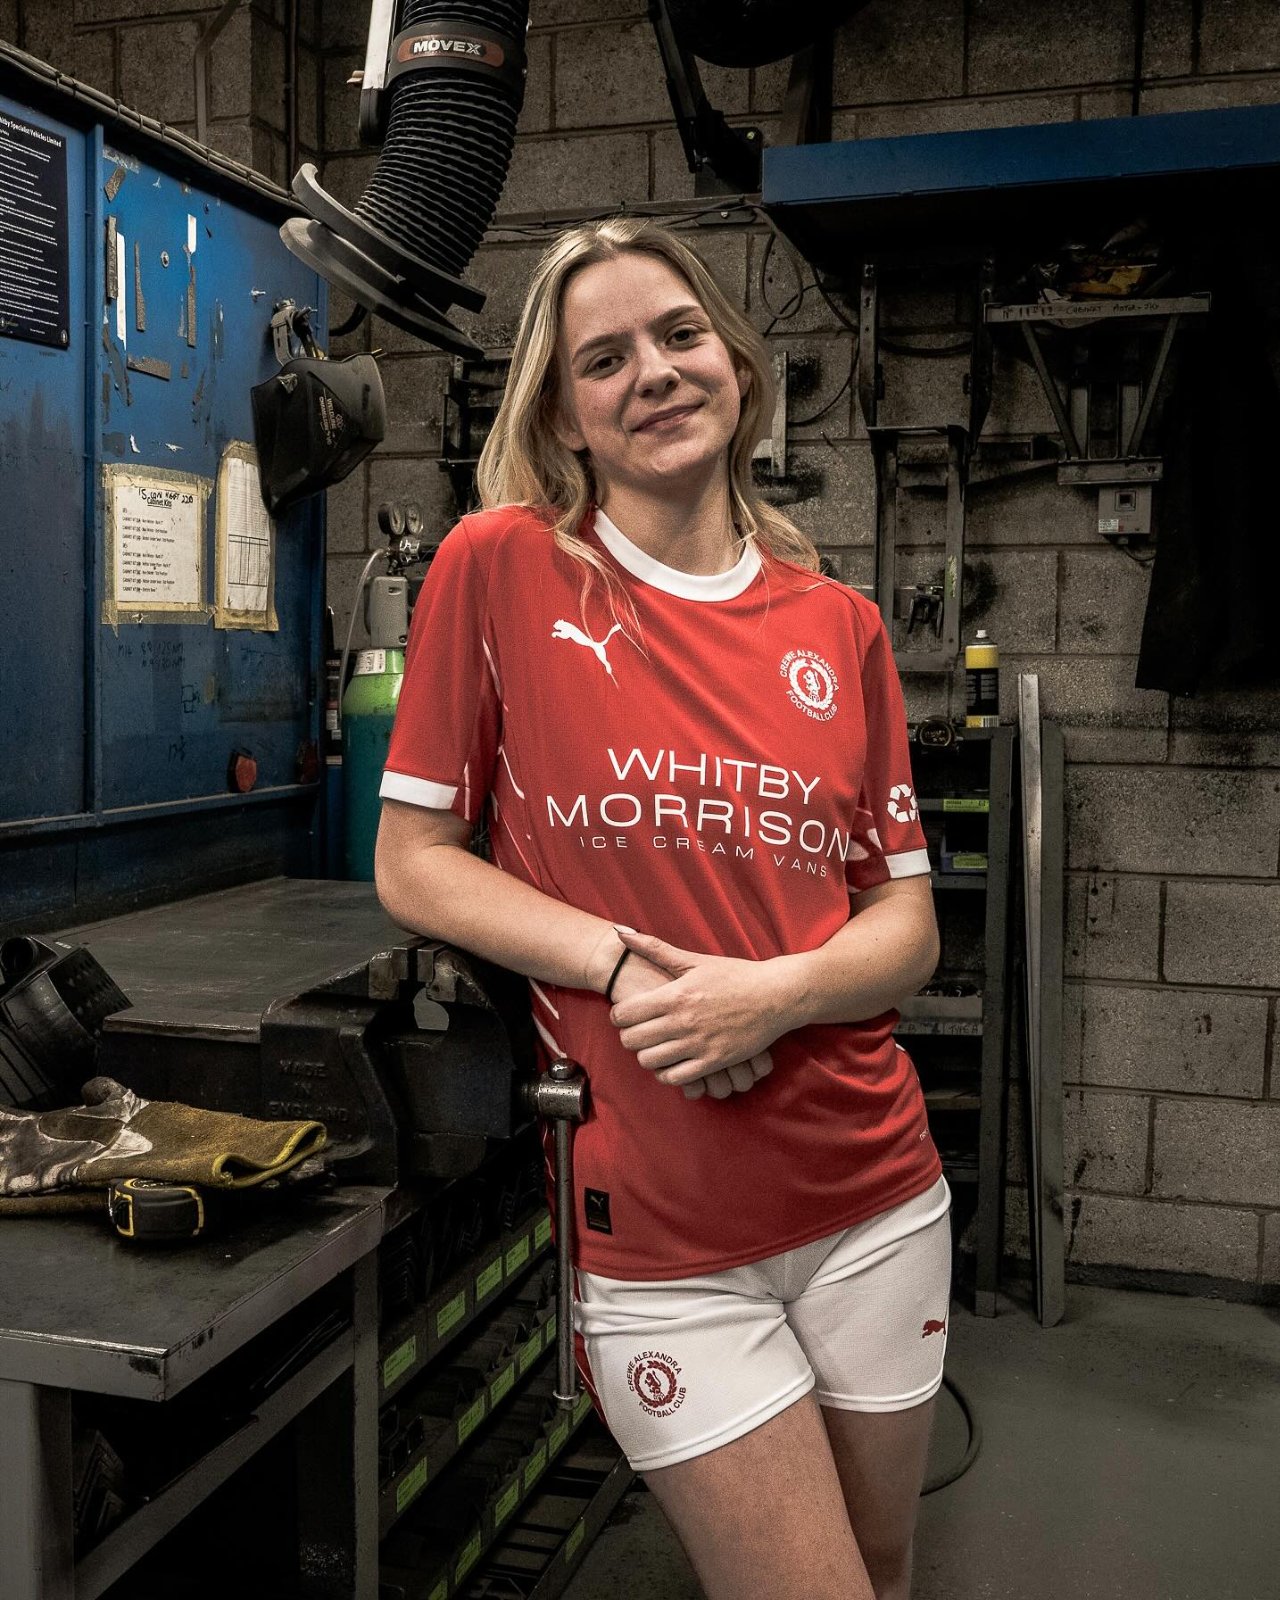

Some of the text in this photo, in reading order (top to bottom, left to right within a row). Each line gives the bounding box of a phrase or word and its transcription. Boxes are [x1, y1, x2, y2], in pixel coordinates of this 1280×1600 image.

[413, 39, 482, 56] MOVEX
[29, 128, 47, 142] Vehicles
[46, 135, 62, 148] Limited
[779, 649, 840, 691] CREWE ALEXANDRA
[786, 689, 838, 722] FOOTBALL CLUB
[607, 747, 821, 805] WHITBY
[545, 792, 850, 863] MORRISON
[579, 835, 828, 878] ICE CREAM VANS
[626, 1350, 682, 1392] CREWE ALEXANDRA
[638, 1386, 687, 1418] FOOTBALL CLUB
